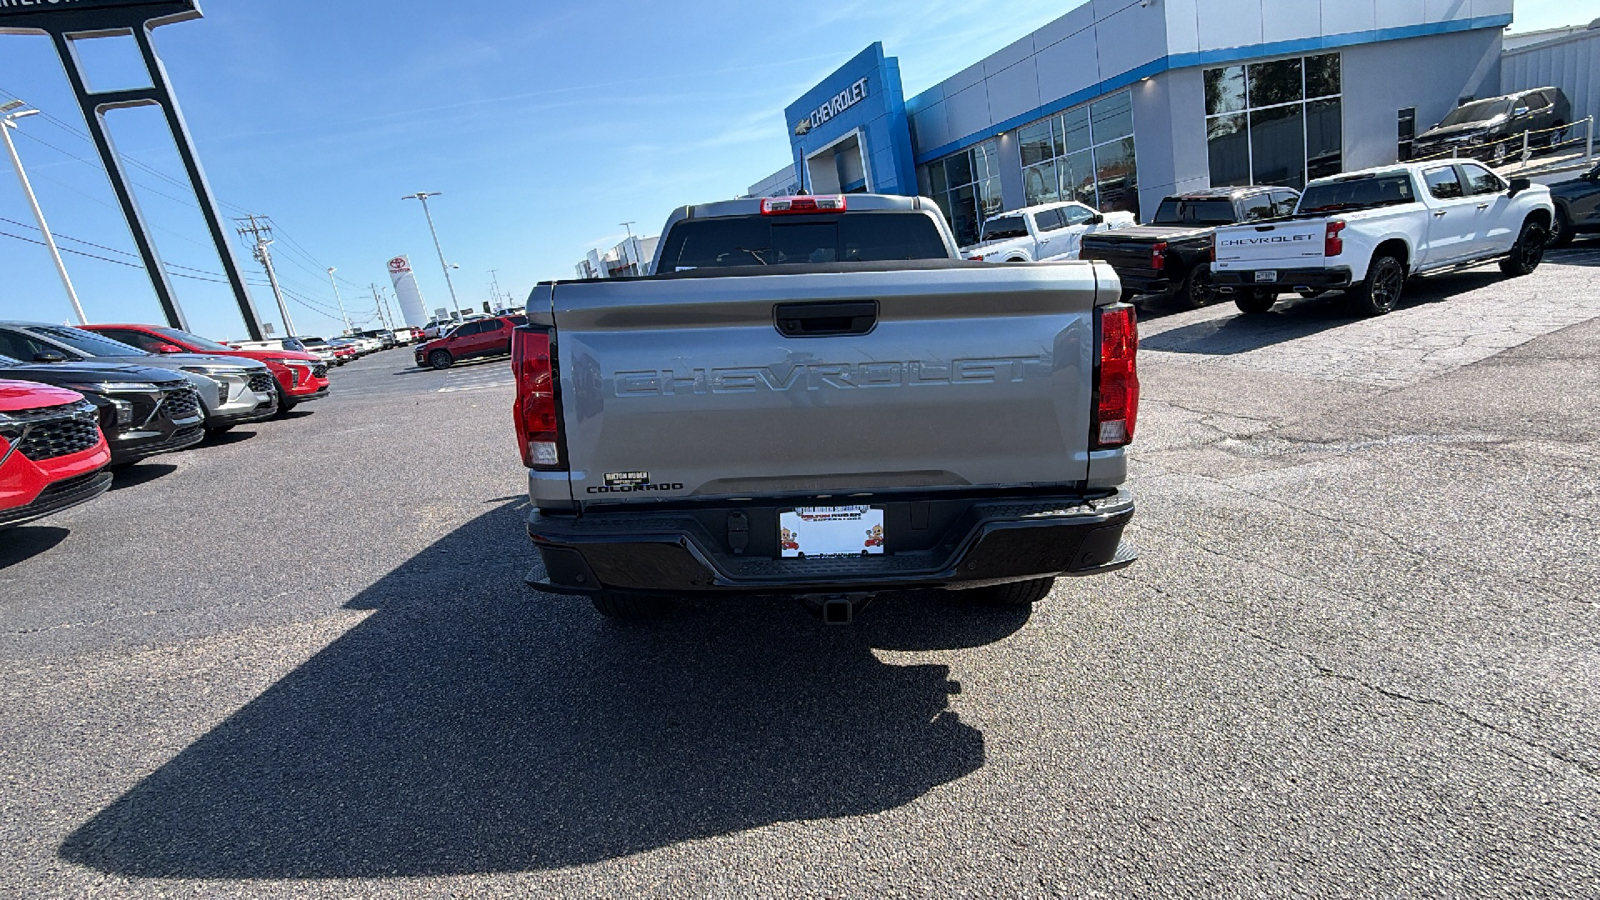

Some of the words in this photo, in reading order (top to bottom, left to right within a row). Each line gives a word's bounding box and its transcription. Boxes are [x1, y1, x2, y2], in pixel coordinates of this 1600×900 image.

[810, 77, 867, 128] CHEVROLET
[1221, 234, 1316, 246] CHEVROLET
[614, 355, 1041, 397] CHEVROLET
[586, 483, 684, 493] COLORADO
